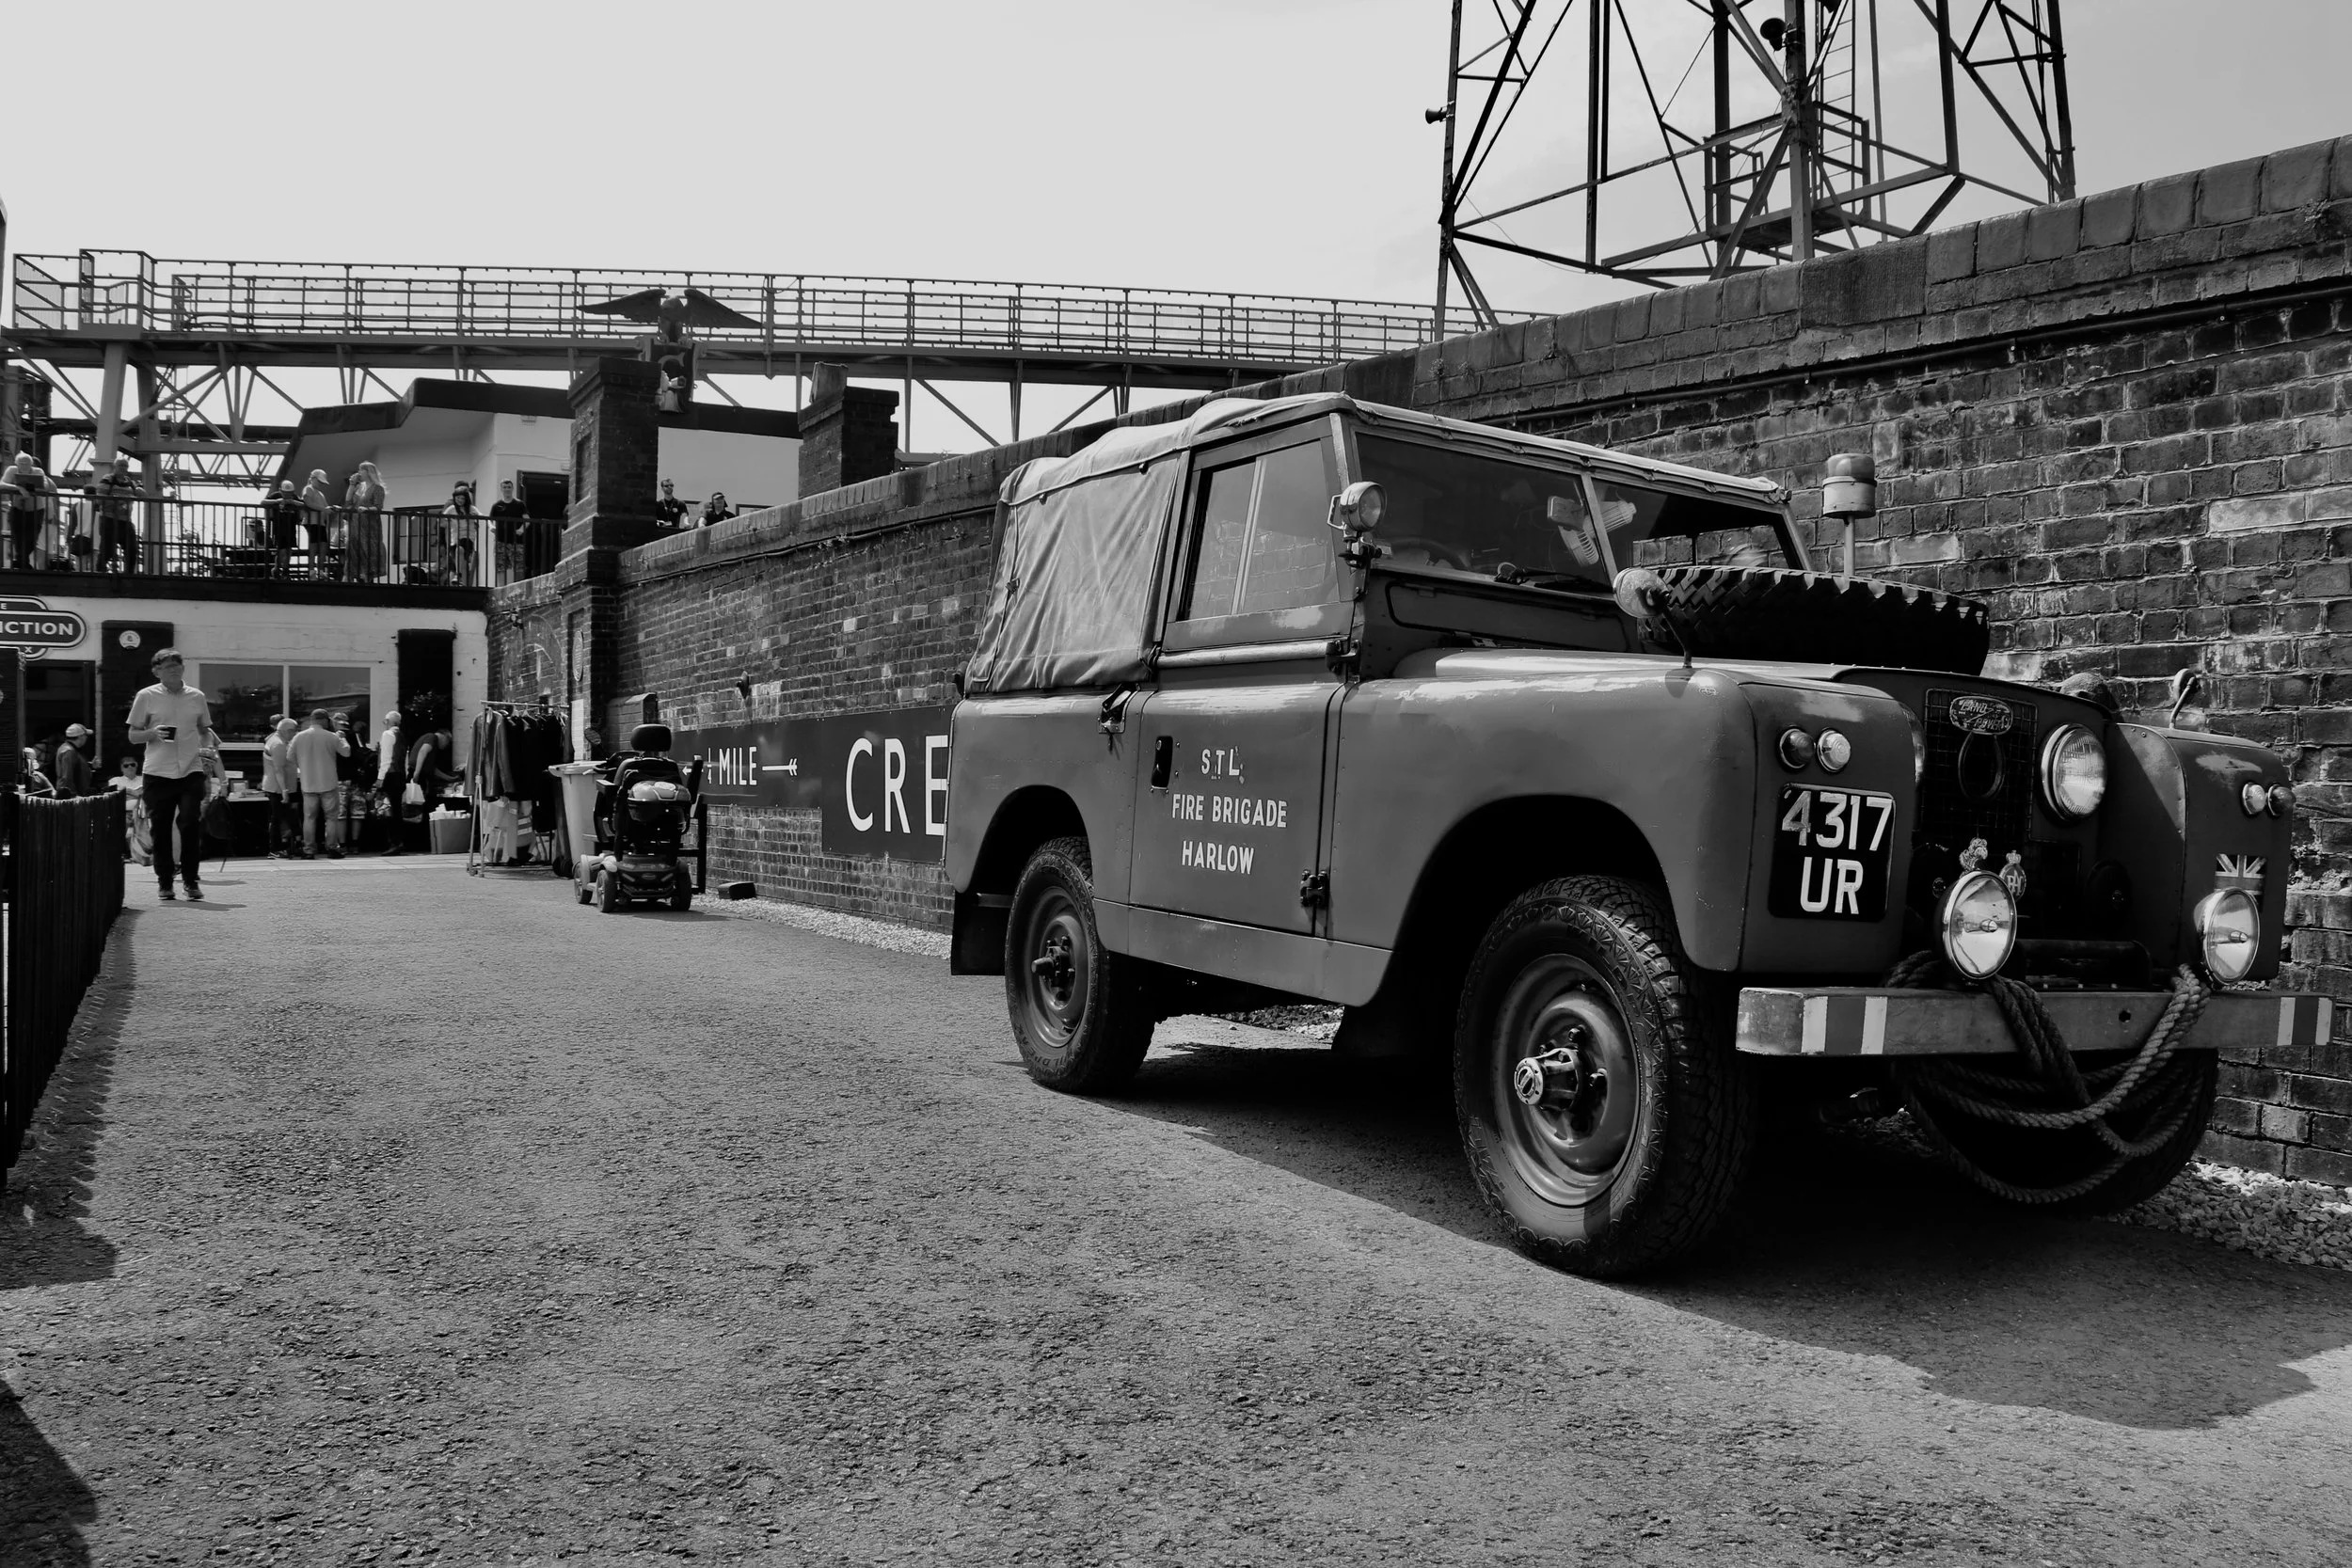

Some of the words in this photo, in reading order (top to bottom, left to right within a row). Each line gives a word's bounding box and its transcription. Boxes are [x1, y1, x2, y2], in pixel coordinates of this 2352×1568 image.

[0, 621, 73, 636] CTION
[719, 746, 756, 785] MILE
[1172, 793, 1204, 821] FIRE
[1212, 795, 1287, 828] BRIGADE
[1782, 790, 1893, 851] 4317
[1182, 840, 1255, 875] HARLOW
[1800, 856, 1864, 914] UR
